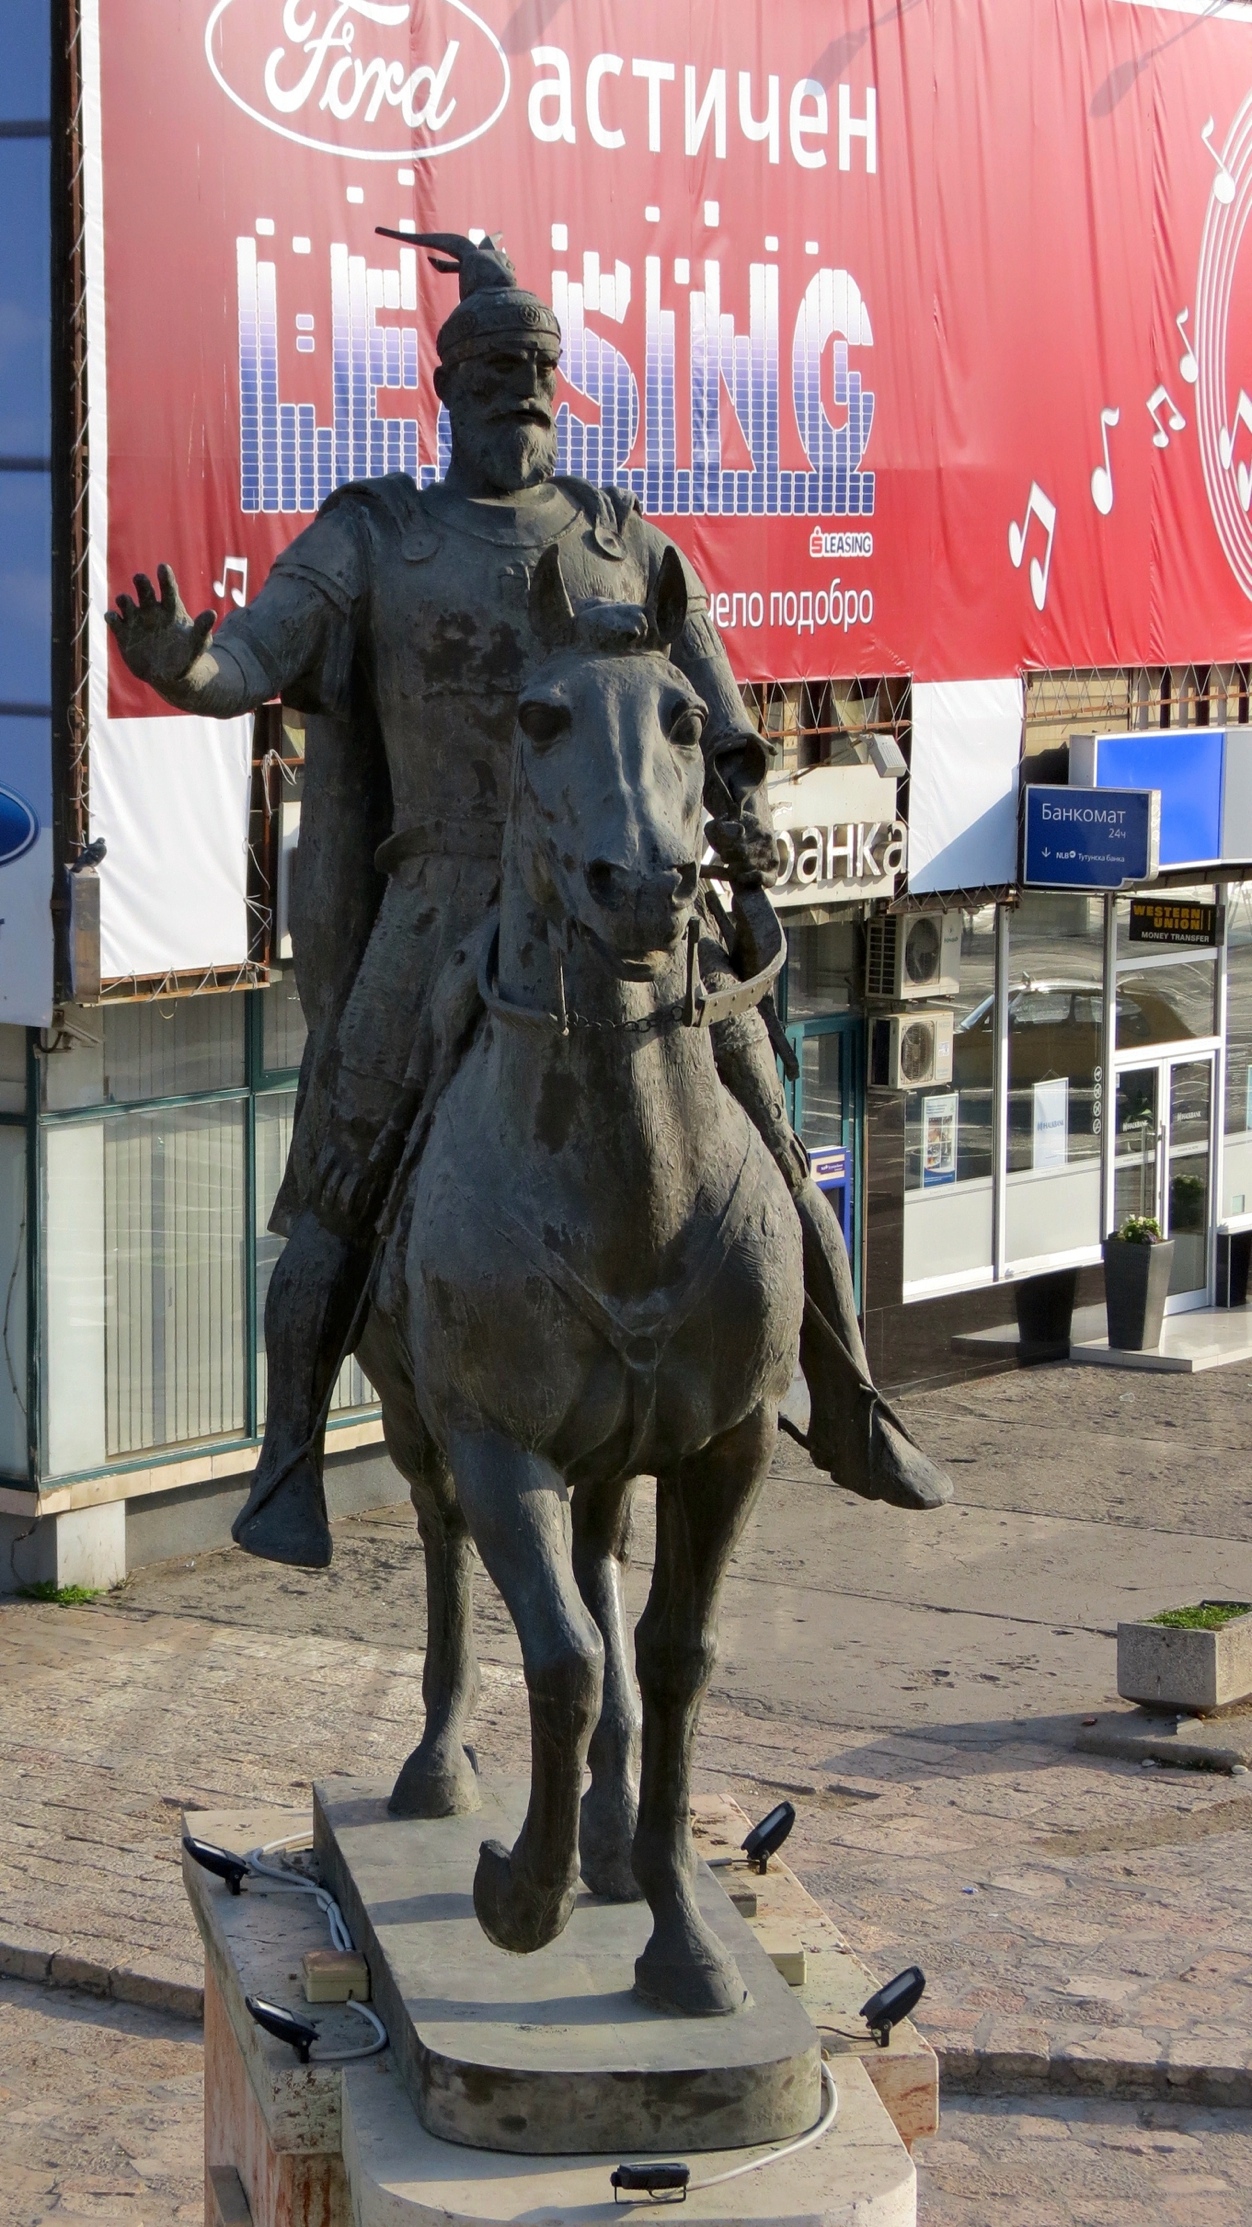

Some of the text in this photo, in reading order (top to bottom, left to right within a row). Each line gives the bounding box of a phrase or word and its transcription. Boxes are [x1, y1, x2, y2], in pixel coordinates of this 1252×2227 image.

[264, 0, 877, 174] Ford астичен
[236, 202, 876, 517] LESING
[770, 578, 873, 635] подобро
[1041, 803, 1126, 824] Банкомат
[1108, 828, 1126, 839] 24ч
[1056, 851, 1070, 860] NLB
[1133, 905, 1200, 919] WESTERN
[1153, 917, 1200, 931] UNION
[1141, 931, 1210, 943] MONEY TRANSFER
